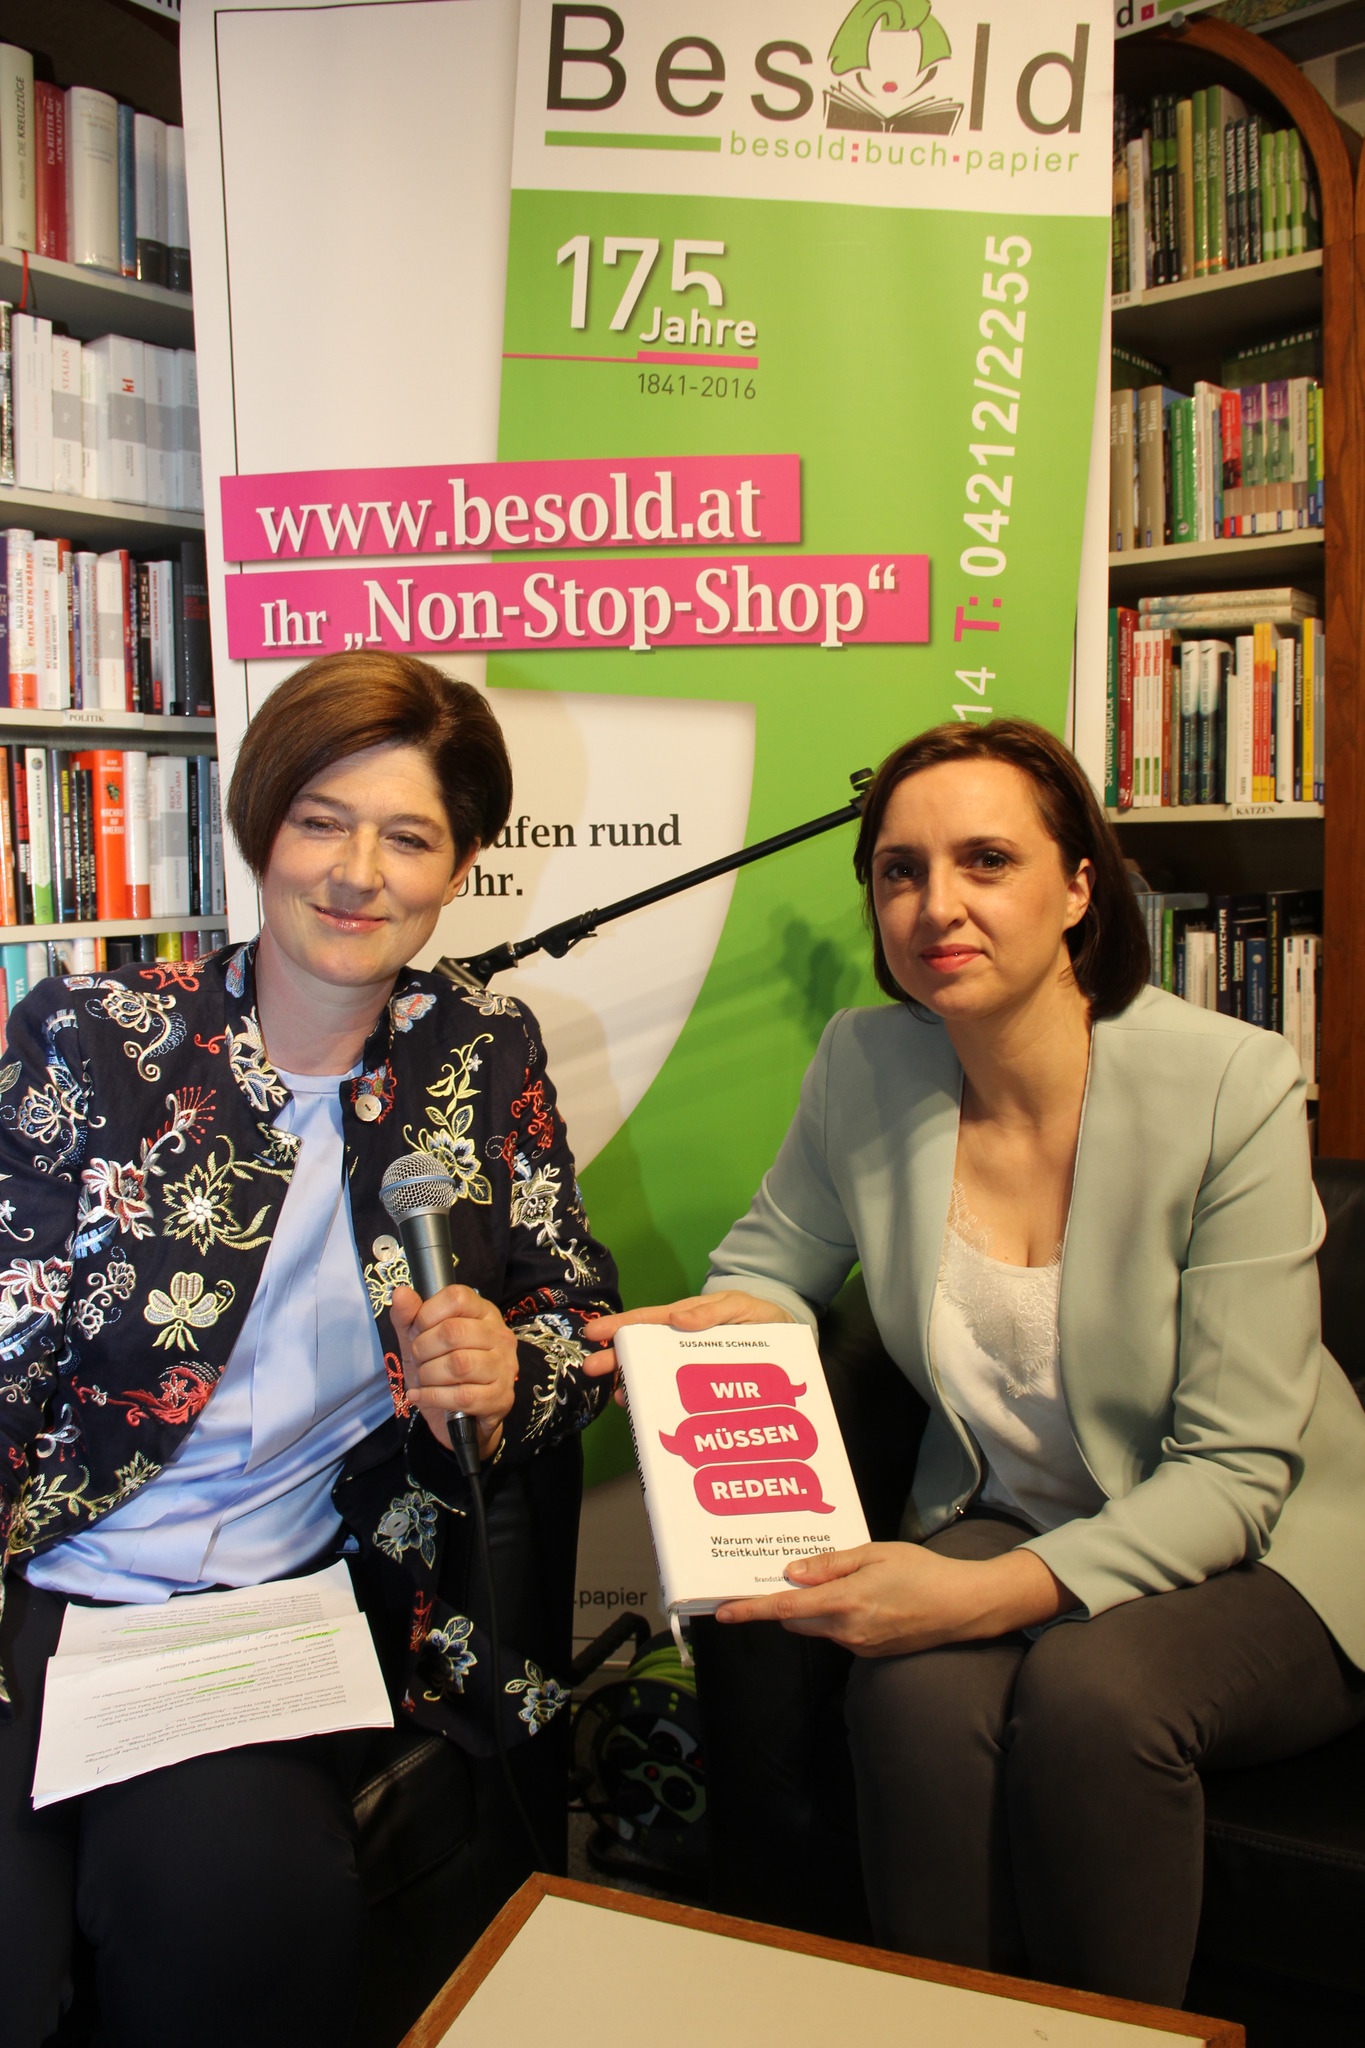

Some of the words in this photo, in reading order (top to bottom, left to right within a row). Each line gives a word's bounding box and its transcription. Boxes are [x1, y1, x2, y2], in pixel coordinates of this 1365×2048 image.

[15, 76, 26, 139] KREUZZÜGE
[47, 115, 55, 148] REITER
[1226, 128, 1236, 197] WALDBADEN
[1237, 126, 1247, 194] WALDBADEN
[1249, 122, 1259, 190] WALDBADEN
[556, 235, 726, 332] 175
[638, 306, 758, 348] Jahre
[62, 350, 70, 391] STALIN
[637, 373, 757, 400] 1841-2016
[960, 235, 1032, 578] 04212/2255
[1118, 403, 1128, 434] Baum
[1147, 400, 1158, 431] Baum
[256, 471, 762, 554] www.besold.at
[25, 552, 33, 587] GRÄBEN
[27, 609, 35, 647] ENTLANG
[260, 600, 328, 648] Ihr
[69, 714, 105, 723] POLITIK
[1236, 805, 1275, 816] KATZEN
[589, 813, 682, 847] rund
[1218, 909, 1227, 992] SKYWATCHER
[725, 1340, 770, 1348] SCHNABL
[710, 1382, 762, 1399] WIR
[693, 1424, 799, 1453] MÜSSEN
[711, 1477, 808, 1500] REDEN.
[710, 1536, 753, 1545] Warum
[755, 1535, 773, 1544] wir
[776, 1534, 801, 1544] eine
[802, 1534, 831, 1543] neue
[711, 1547, 780, 1558] Streitkultur
[782, 1545, 836, 1556] brauchen
